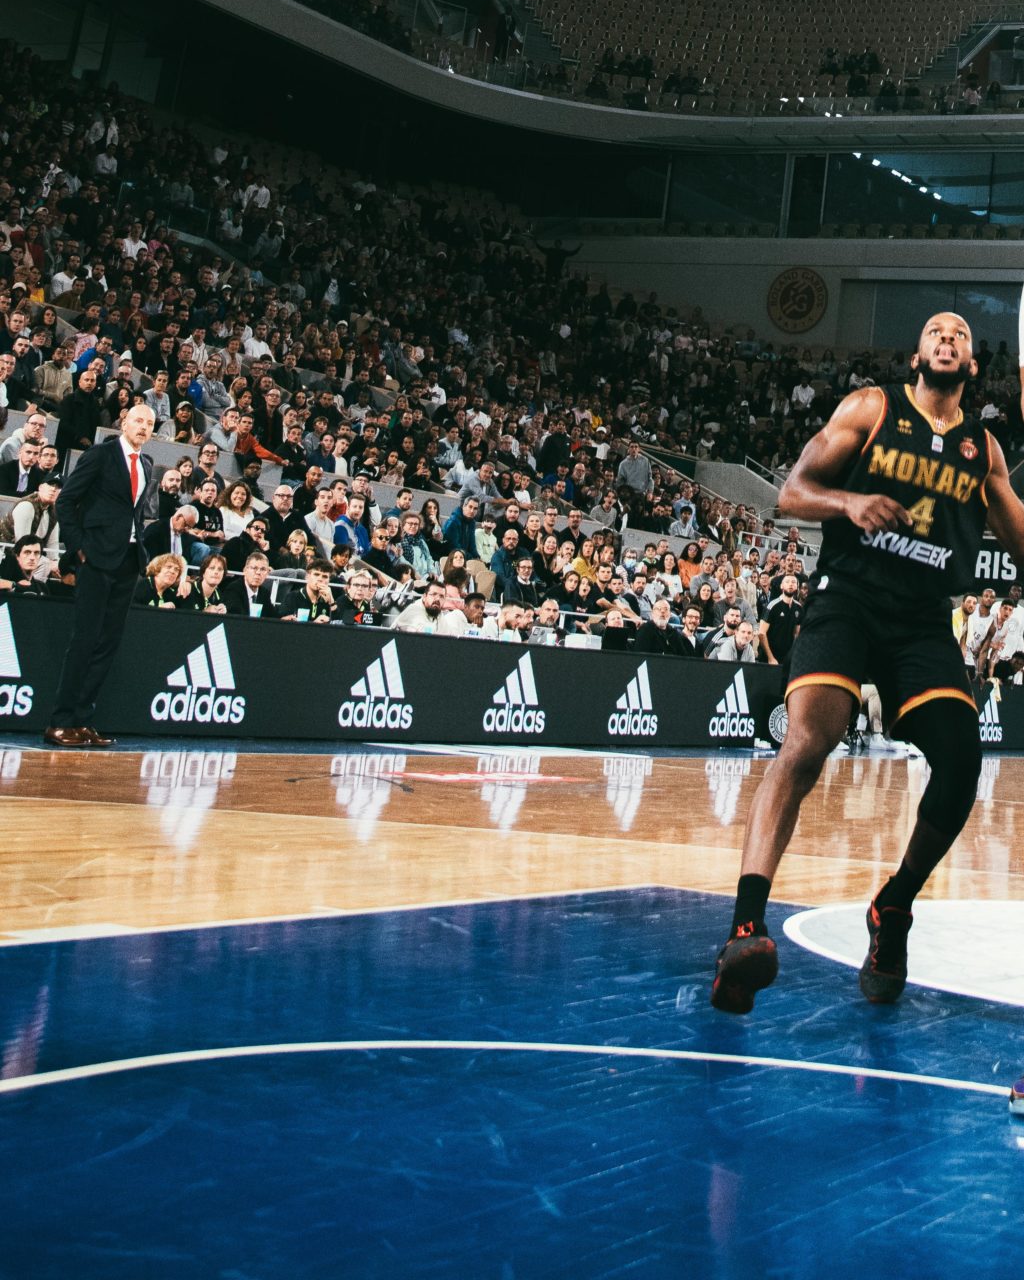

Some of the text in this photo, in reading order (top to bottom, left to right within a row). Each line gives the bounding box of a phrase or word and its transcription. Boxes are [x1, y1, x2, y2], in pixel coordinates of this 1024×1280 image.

[906, 496, 935, 537] 4
[859, 526, 954, 571] SKWEEK
[151, 684, 246, 723] adidas
[338, 695, 413, 730] adidas
[483, 702, 546, 734] adidas
[608, 708, 658, 737] adidas
[708, 712, 755, 738] adidas
